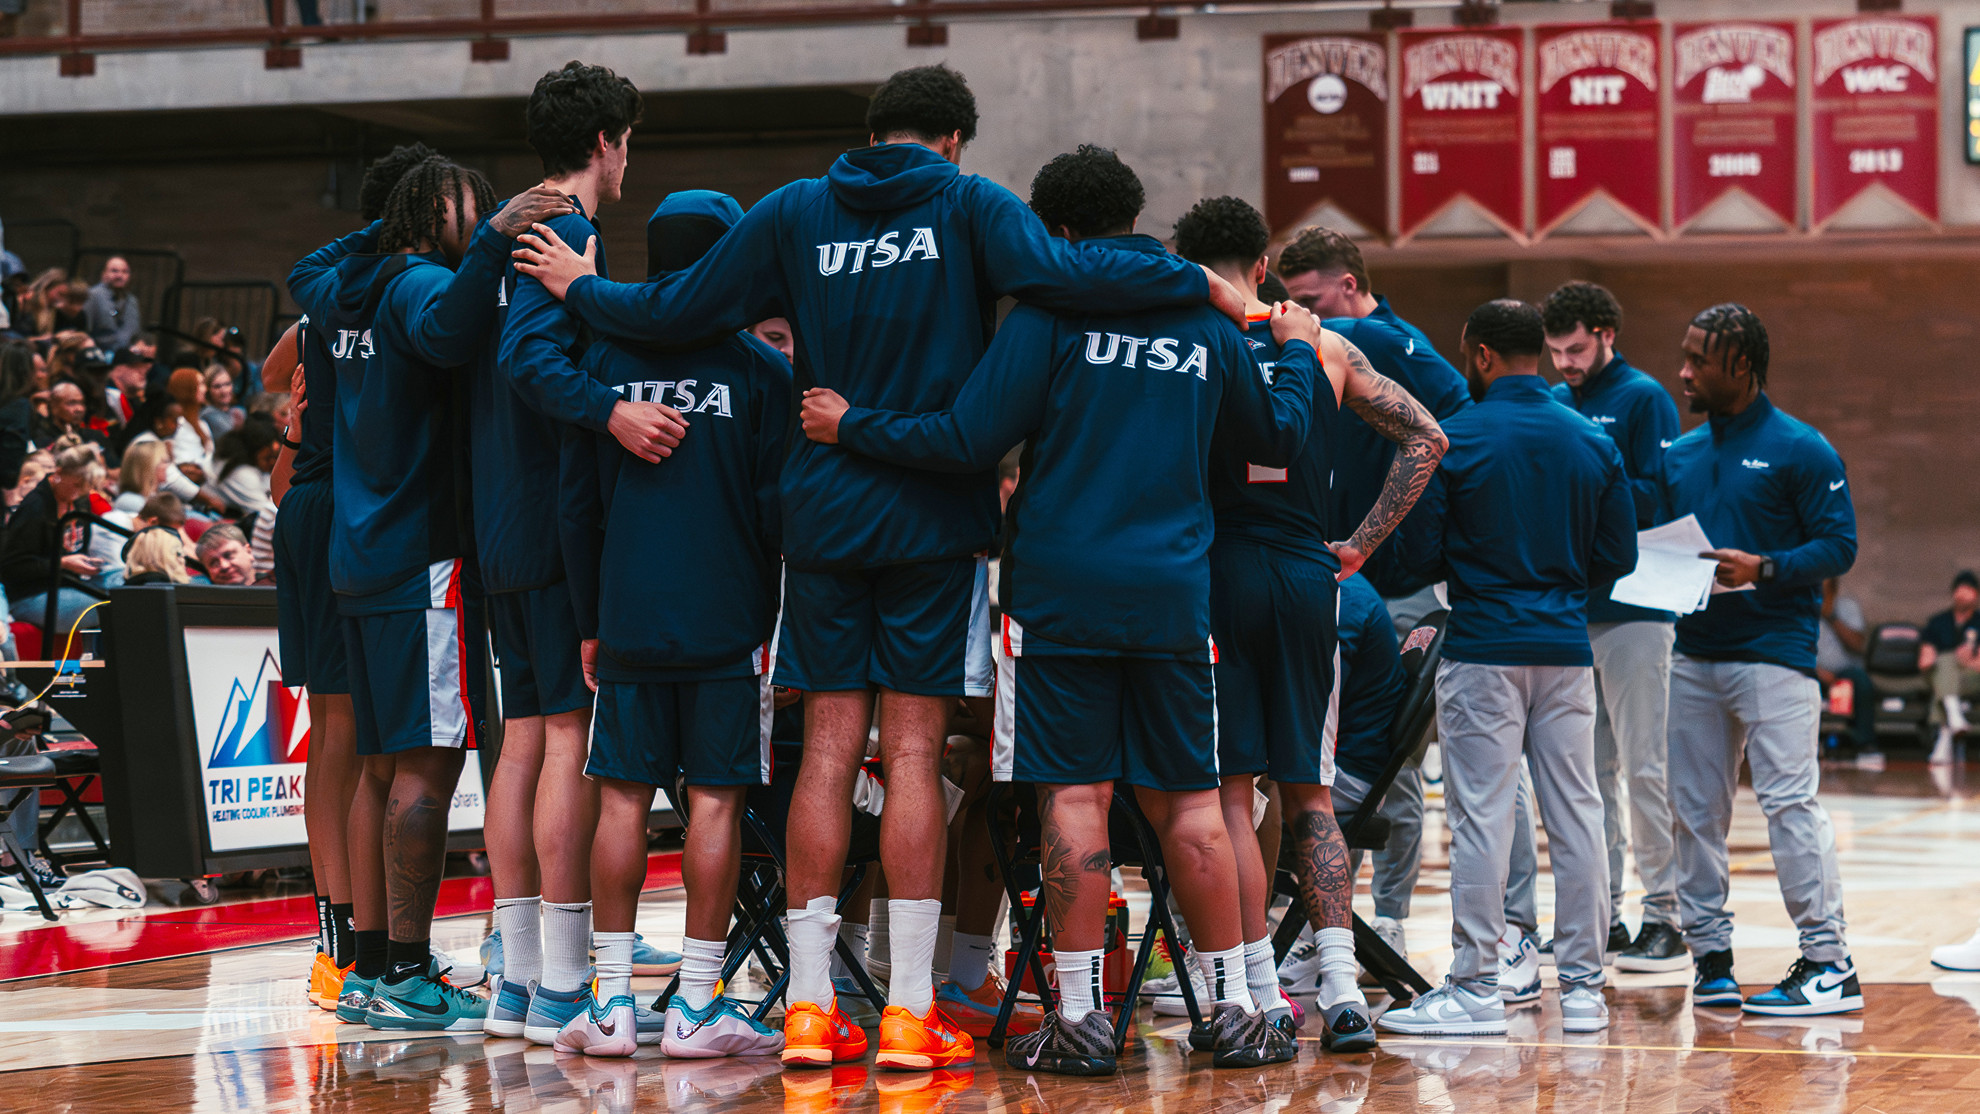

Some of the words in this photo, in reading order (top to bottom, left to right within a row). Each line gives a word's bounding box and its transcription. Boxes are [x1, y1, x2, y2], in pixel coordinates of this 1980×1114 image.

[1569, 75, 1626, 105] NIT
[1841, 64, 1911, 93] WAC
[1421, 80, 1502, 110] WNIT
[816, 227, 940, 277] UTSA
[1085, 332, 1207, 381] UTSA
[209, 779, 240, 805] TRI
[212, 809, 241, 823] HEATING
[242, 806, 270, 820] COOLING
